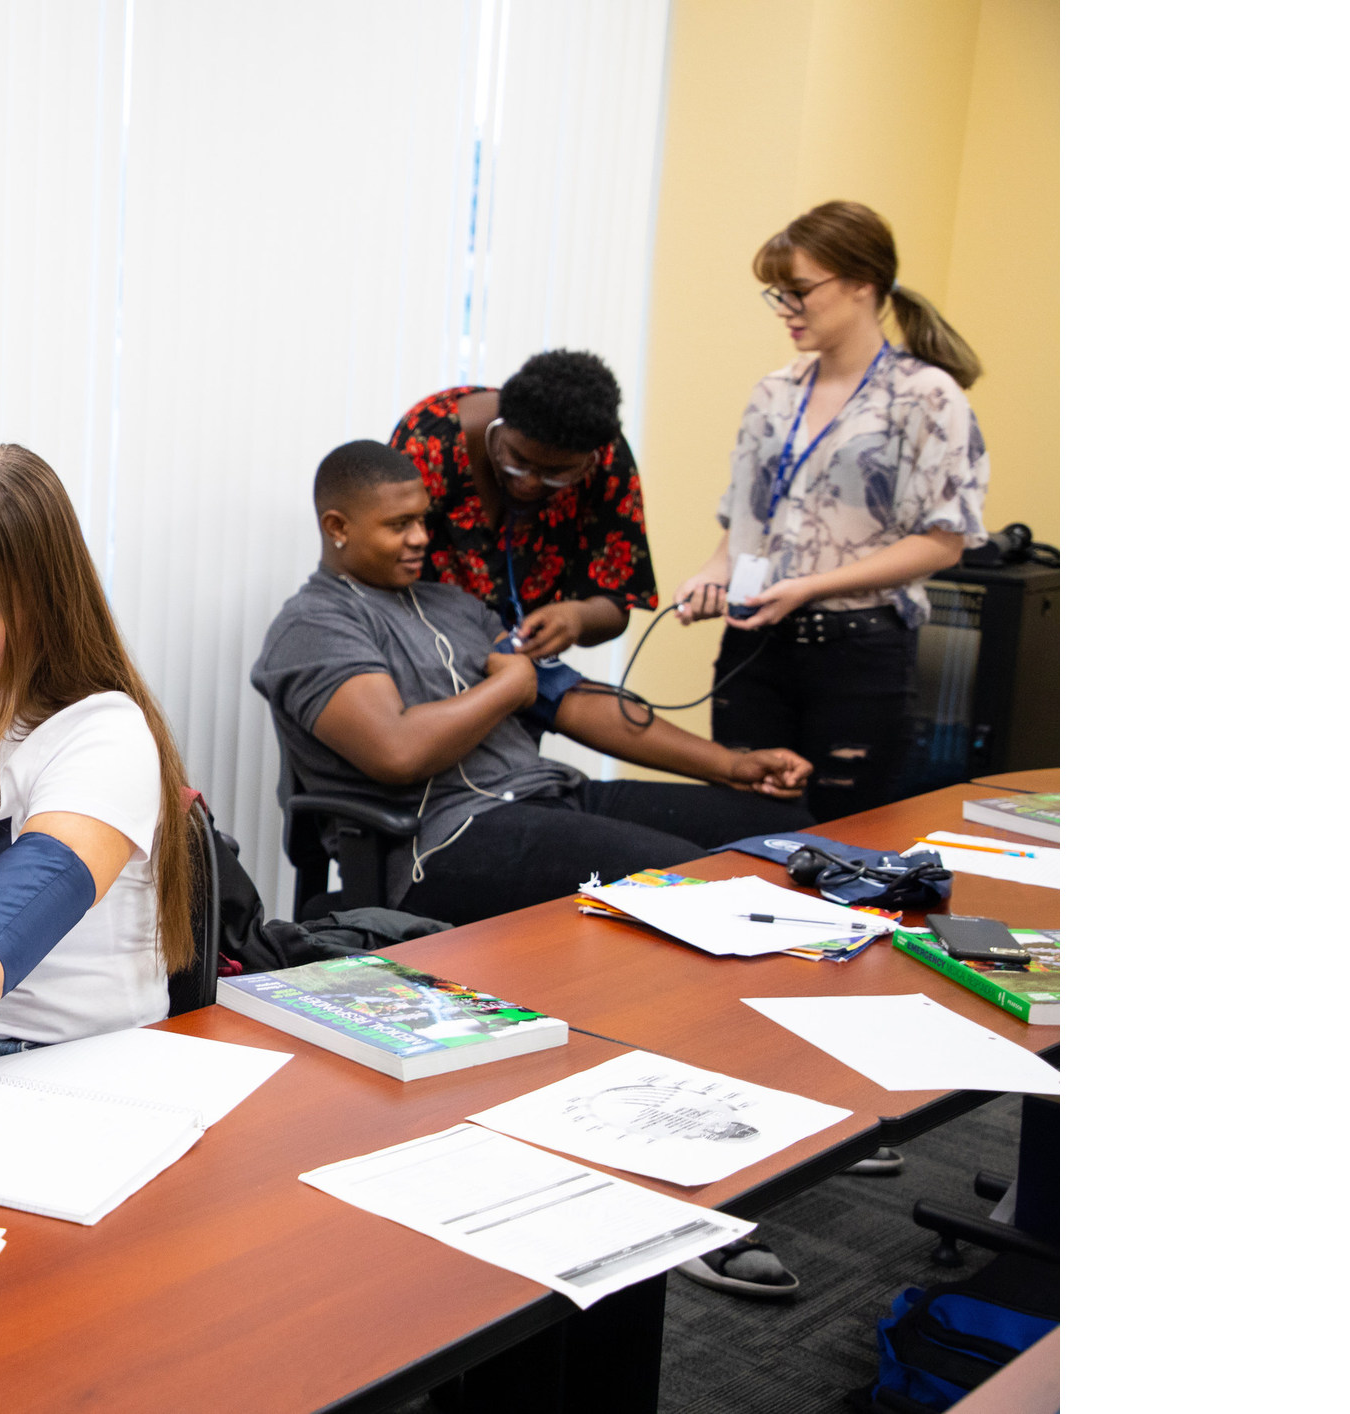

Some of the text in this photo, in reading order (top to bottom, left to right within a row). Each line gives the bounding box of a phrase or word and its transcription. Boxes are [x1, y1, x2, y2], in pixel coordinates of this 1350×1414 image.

[906, 940, 947, 968] EMERGENCY
[1006, 999, 1024, 1012] PEARSON
[279, 997, 412, 1049] EMERGENCY
[298, 994, 427, 1046] MEDICAL RESPONDER
